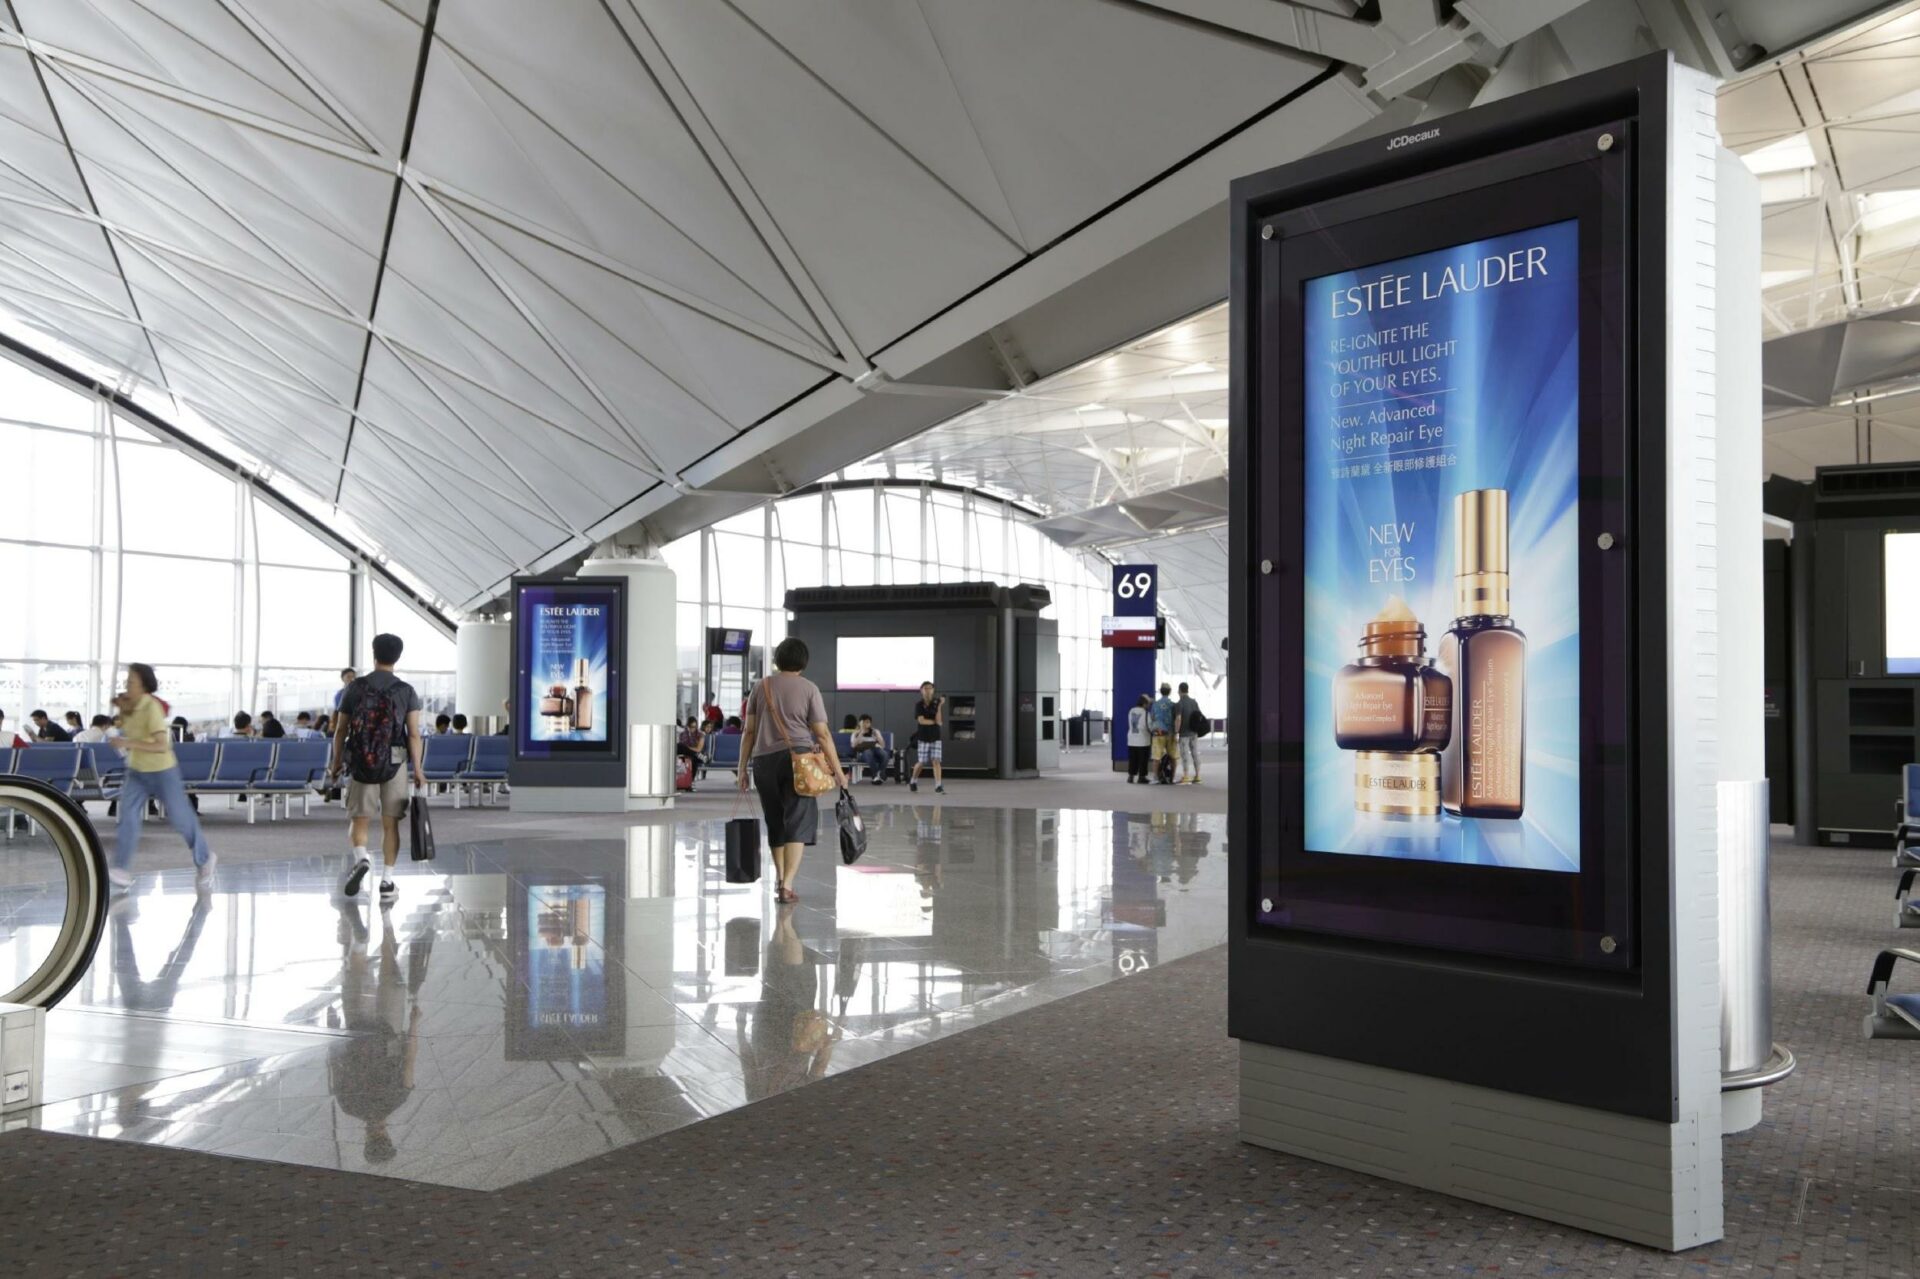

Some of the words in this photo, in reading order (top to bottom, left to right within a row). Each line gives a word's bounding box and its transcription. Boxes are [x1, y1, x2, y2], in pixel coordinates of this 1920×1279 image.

[1386, 128, 1440, 151] JCDecaux
[1422, 246, 1548, 301] LAUDER
[1330, 328, 1398, 354] RE-IGNITE
[1401, 322, 1429, 341] THE
[1330, 349, 1408, 376] YOUTHFUL
[1412, 339, 1458, 362] LIGHT
[1330, 381, 1351, 398] OF
[1354, 373, 1397, 394] YOUR
[1402, 366, 1441, 387] EYES.
[1330, 415, 1363, 430] New.
[1367, 399, 1436, 425] Advanced
[1330, 433, 1367, 454] Night
[1370, 427, 1414, 449] Repair
[1419, 424, 1443, 444] Eye
[1369, 521, 1415, 546] NEW
[1384, 547, 1402, 558] FOR
[1369, 556, 1416, 583] EYES
[1117, 572, 1152, 599] 69
[566, 607, 600, 616] LAUDER
[1472, 699, 1483, 755] LAUDER
[1393, 779, 1426, 790] LAUDER
